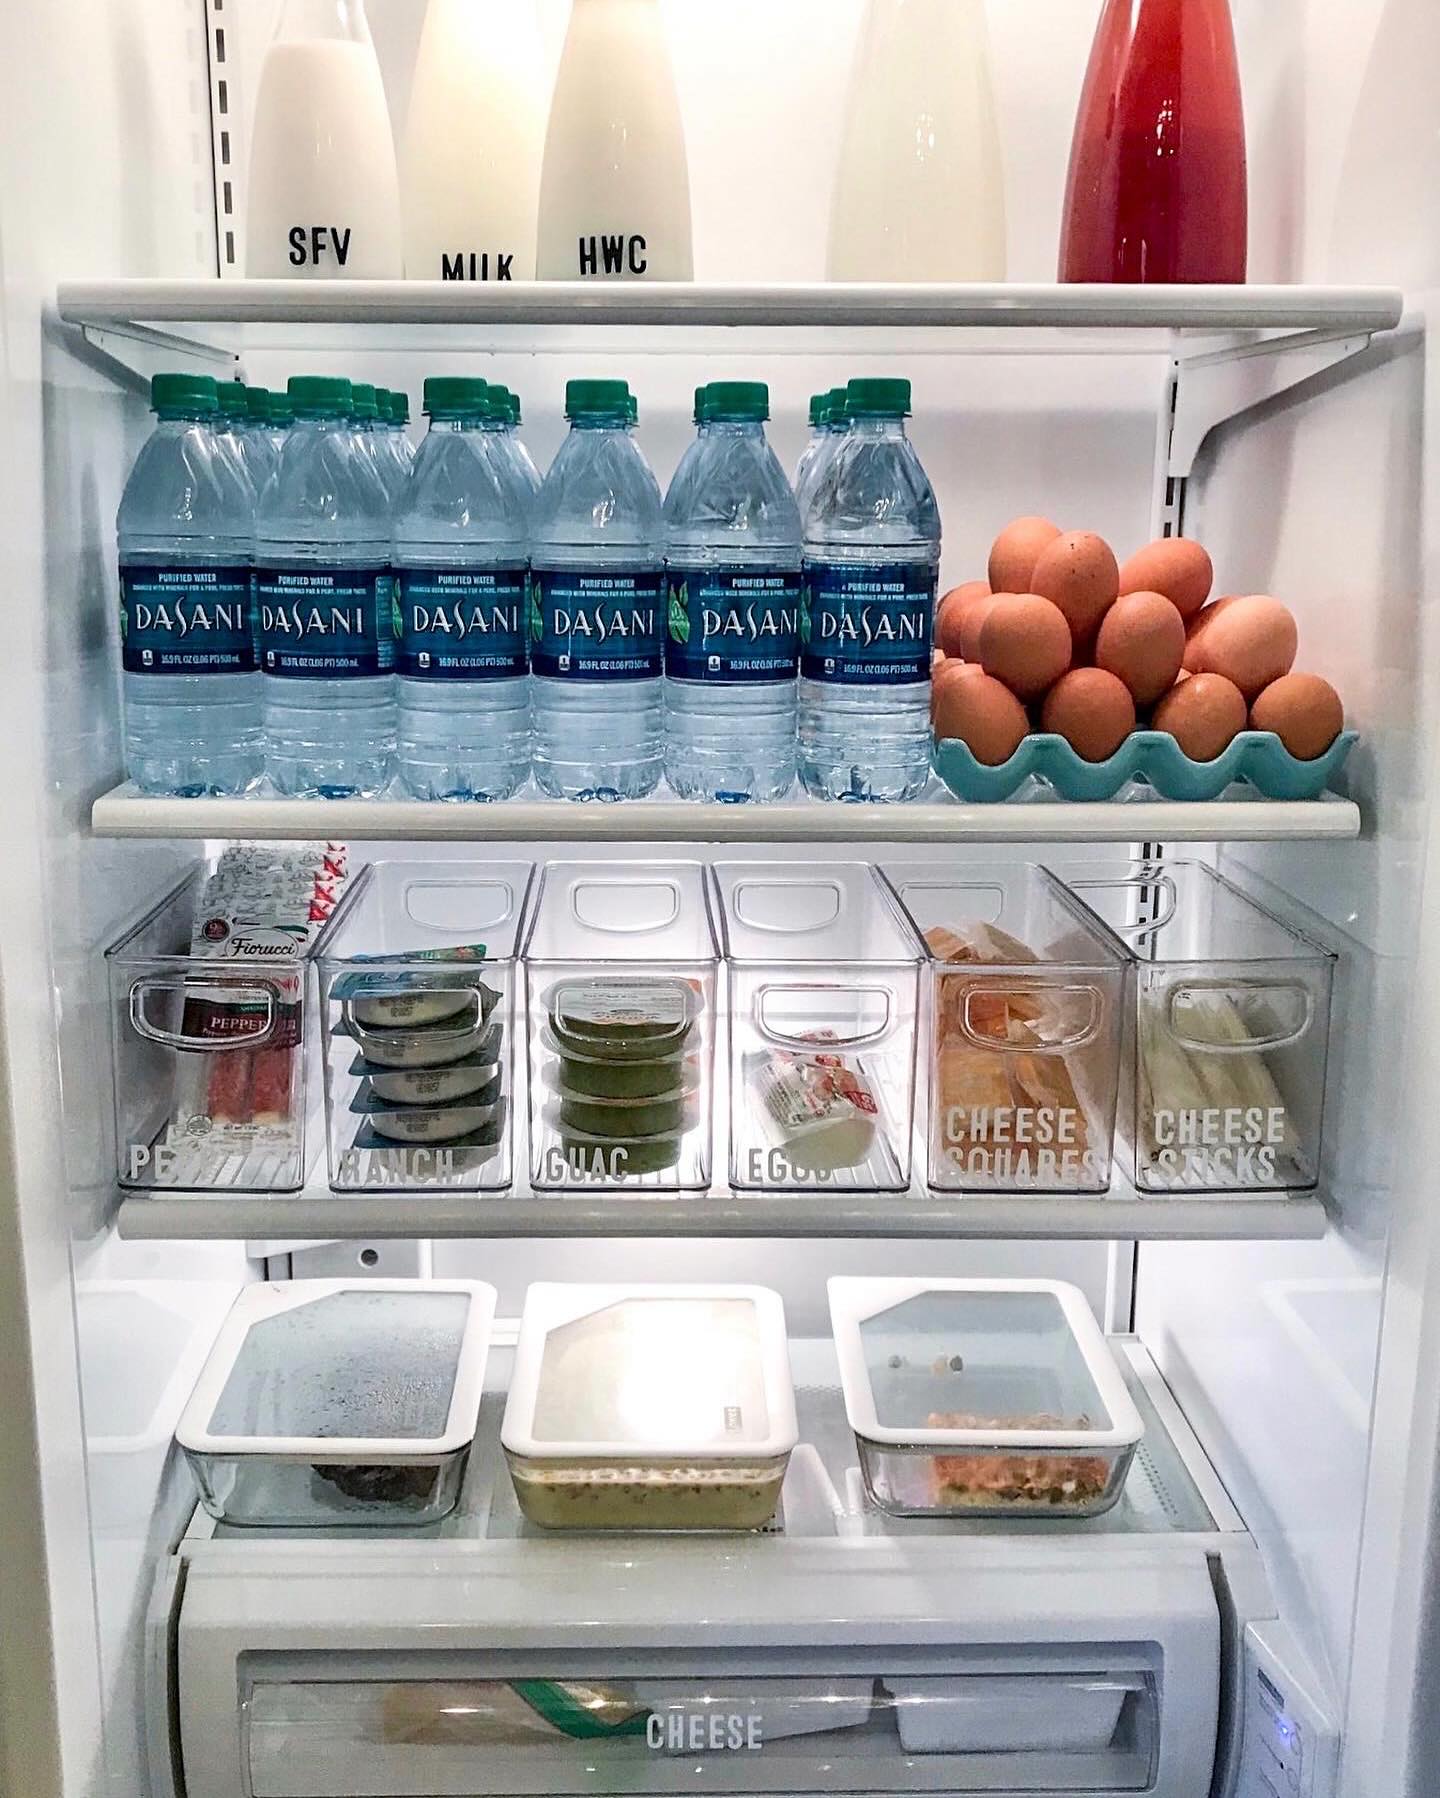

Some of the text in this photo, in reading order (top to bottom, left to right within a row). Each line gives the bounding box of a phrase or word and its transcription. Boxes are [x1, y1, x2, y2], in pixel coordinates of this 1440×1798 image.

[288, 226, 352, 266] SFV
[579, 235, 647, 275] HWC
[442, 253, 514, 281] MILK
[158, 573, 217, 583] PURIFIED WATER
[278, 575, 334, 586] PURIFIED WATER
[438, 575, 495, 585] PURIFIED WATER
[579, 579, 635, 588] PURIFIED WATER
[732, 578, 784, 588] PURIFIED WATER
[847, 582, 905, 592] PURIFIED WATER
[136, 596, 243, 637] DASANI
[262, 599, 362, 640] DASANI
[413, 600, 518, 639] DASANI
[554, 602, 654, 643] DASANI
[702, 601, 797, 642] DASANI
[822, 606, 924, 647] DASANI
[231, 938, 295, 957] Fiorucci
[946, 1106, 1076, 1143] CHEESE
[1155, 1106, 1285, 1145] CHEESE
[341, 1149, 454, 1183] RANCH
[545, 1147, 629, 1182] GUAC
[945, 1147, 1099, 1186] SQUARES
[1158, 1146, 1276, 1183] STICKS
[646, 1713, 763, 1750] CHEESE
